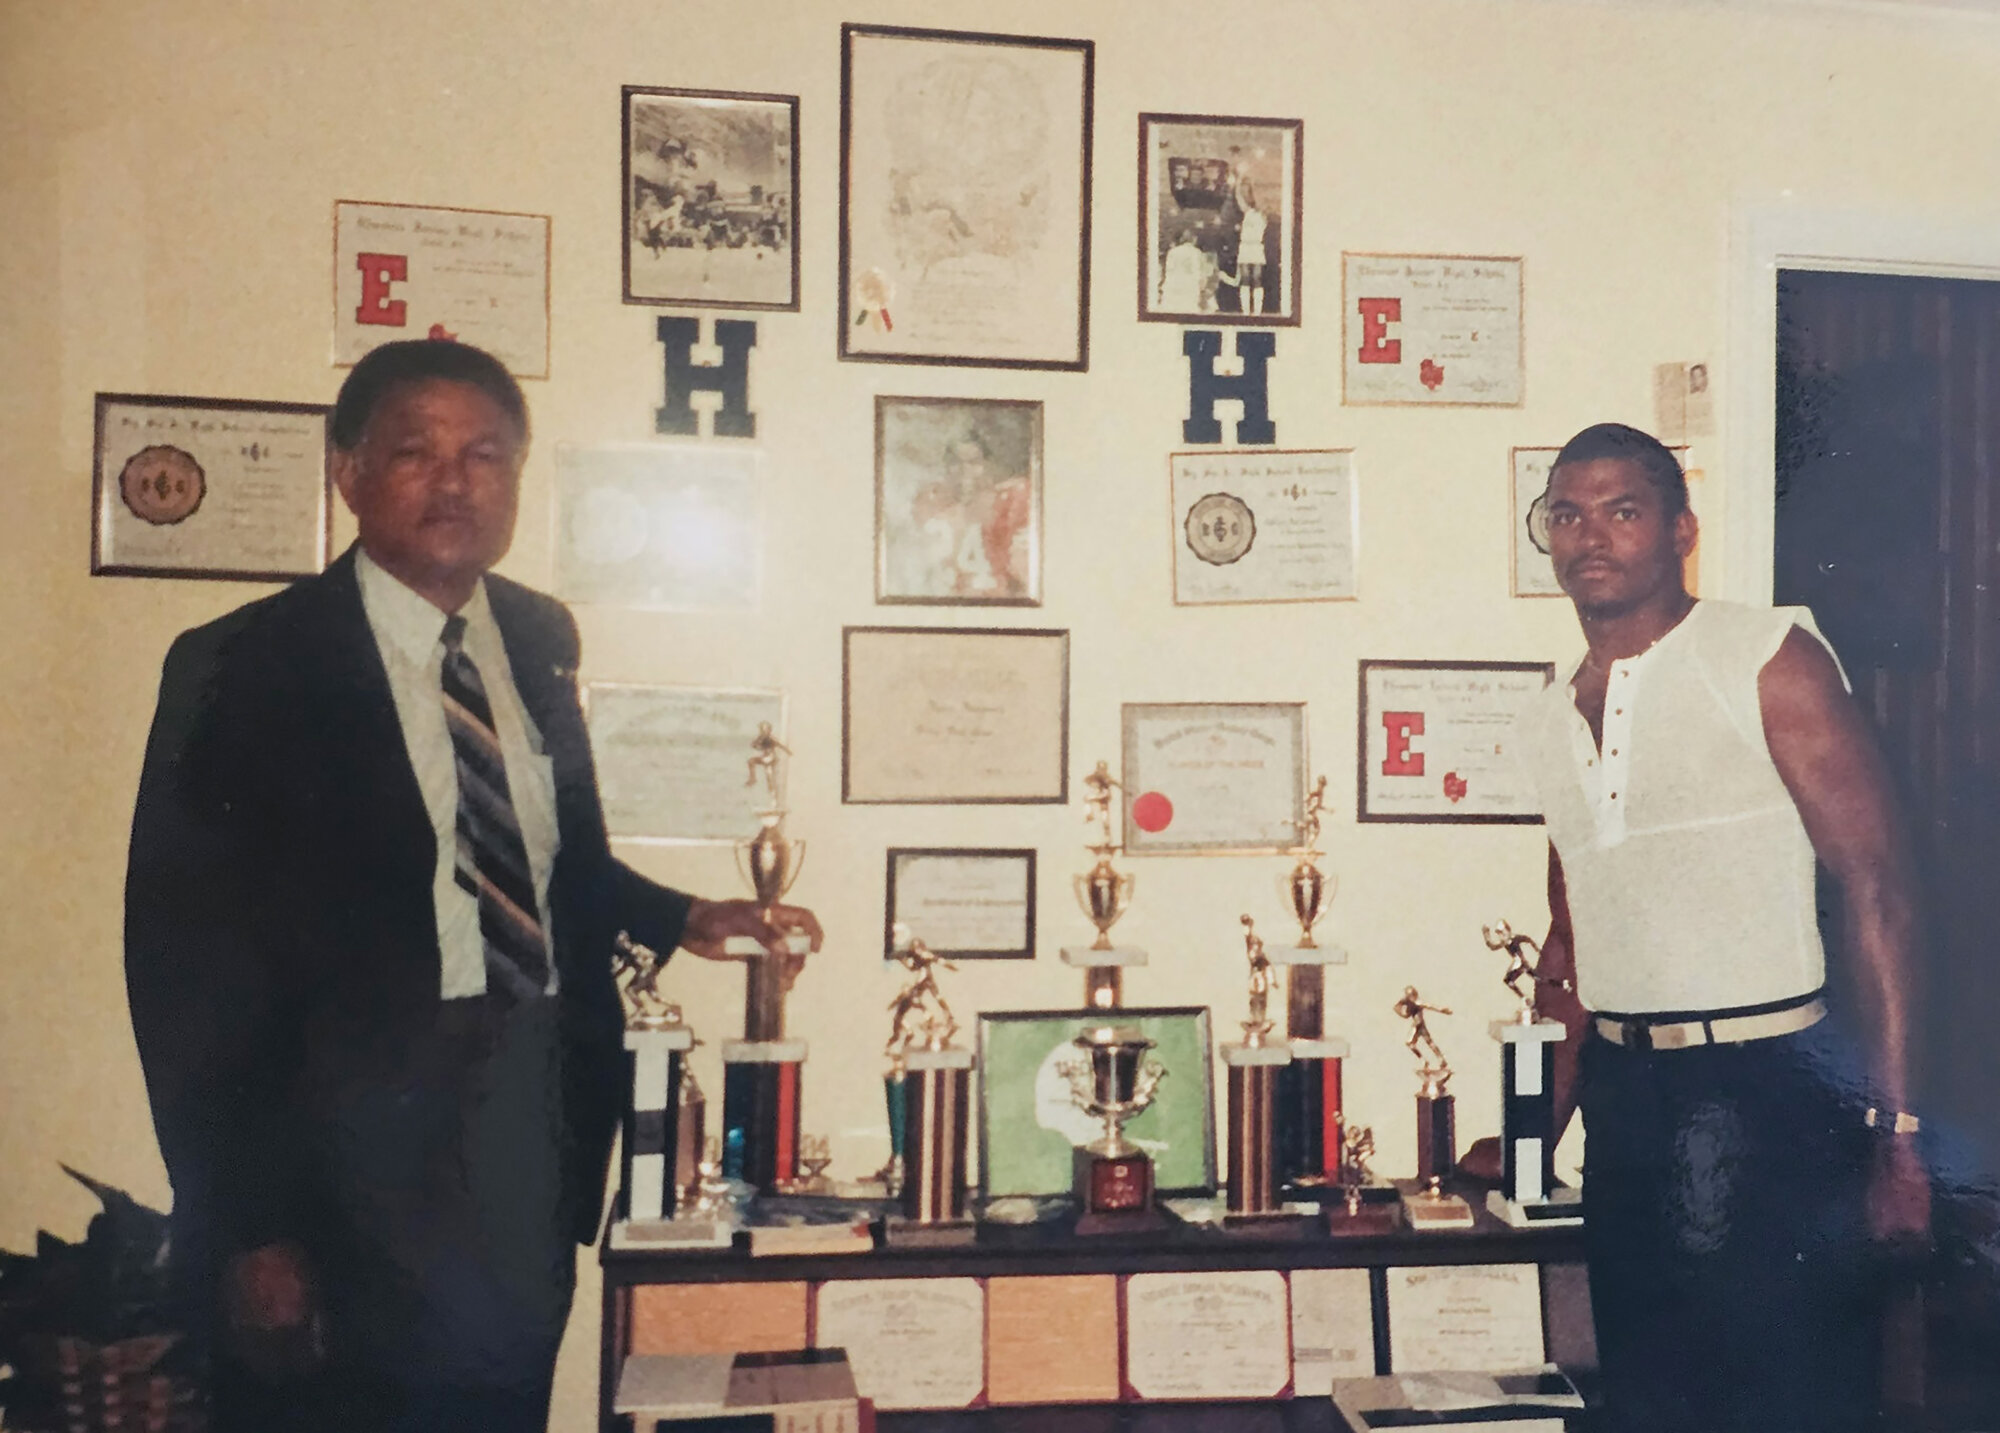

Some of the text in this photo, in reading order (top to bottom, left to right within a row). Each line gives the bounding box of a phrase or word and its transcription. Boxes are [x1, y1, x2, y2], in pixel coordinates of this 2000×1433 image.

[356, 252, 407, 327] E
[1358, 297, 1401, 364] E
[655, 316, 757, 438] H
[1182, 330, 1276, 444] H
[1381, 711, 1425, 776] E
